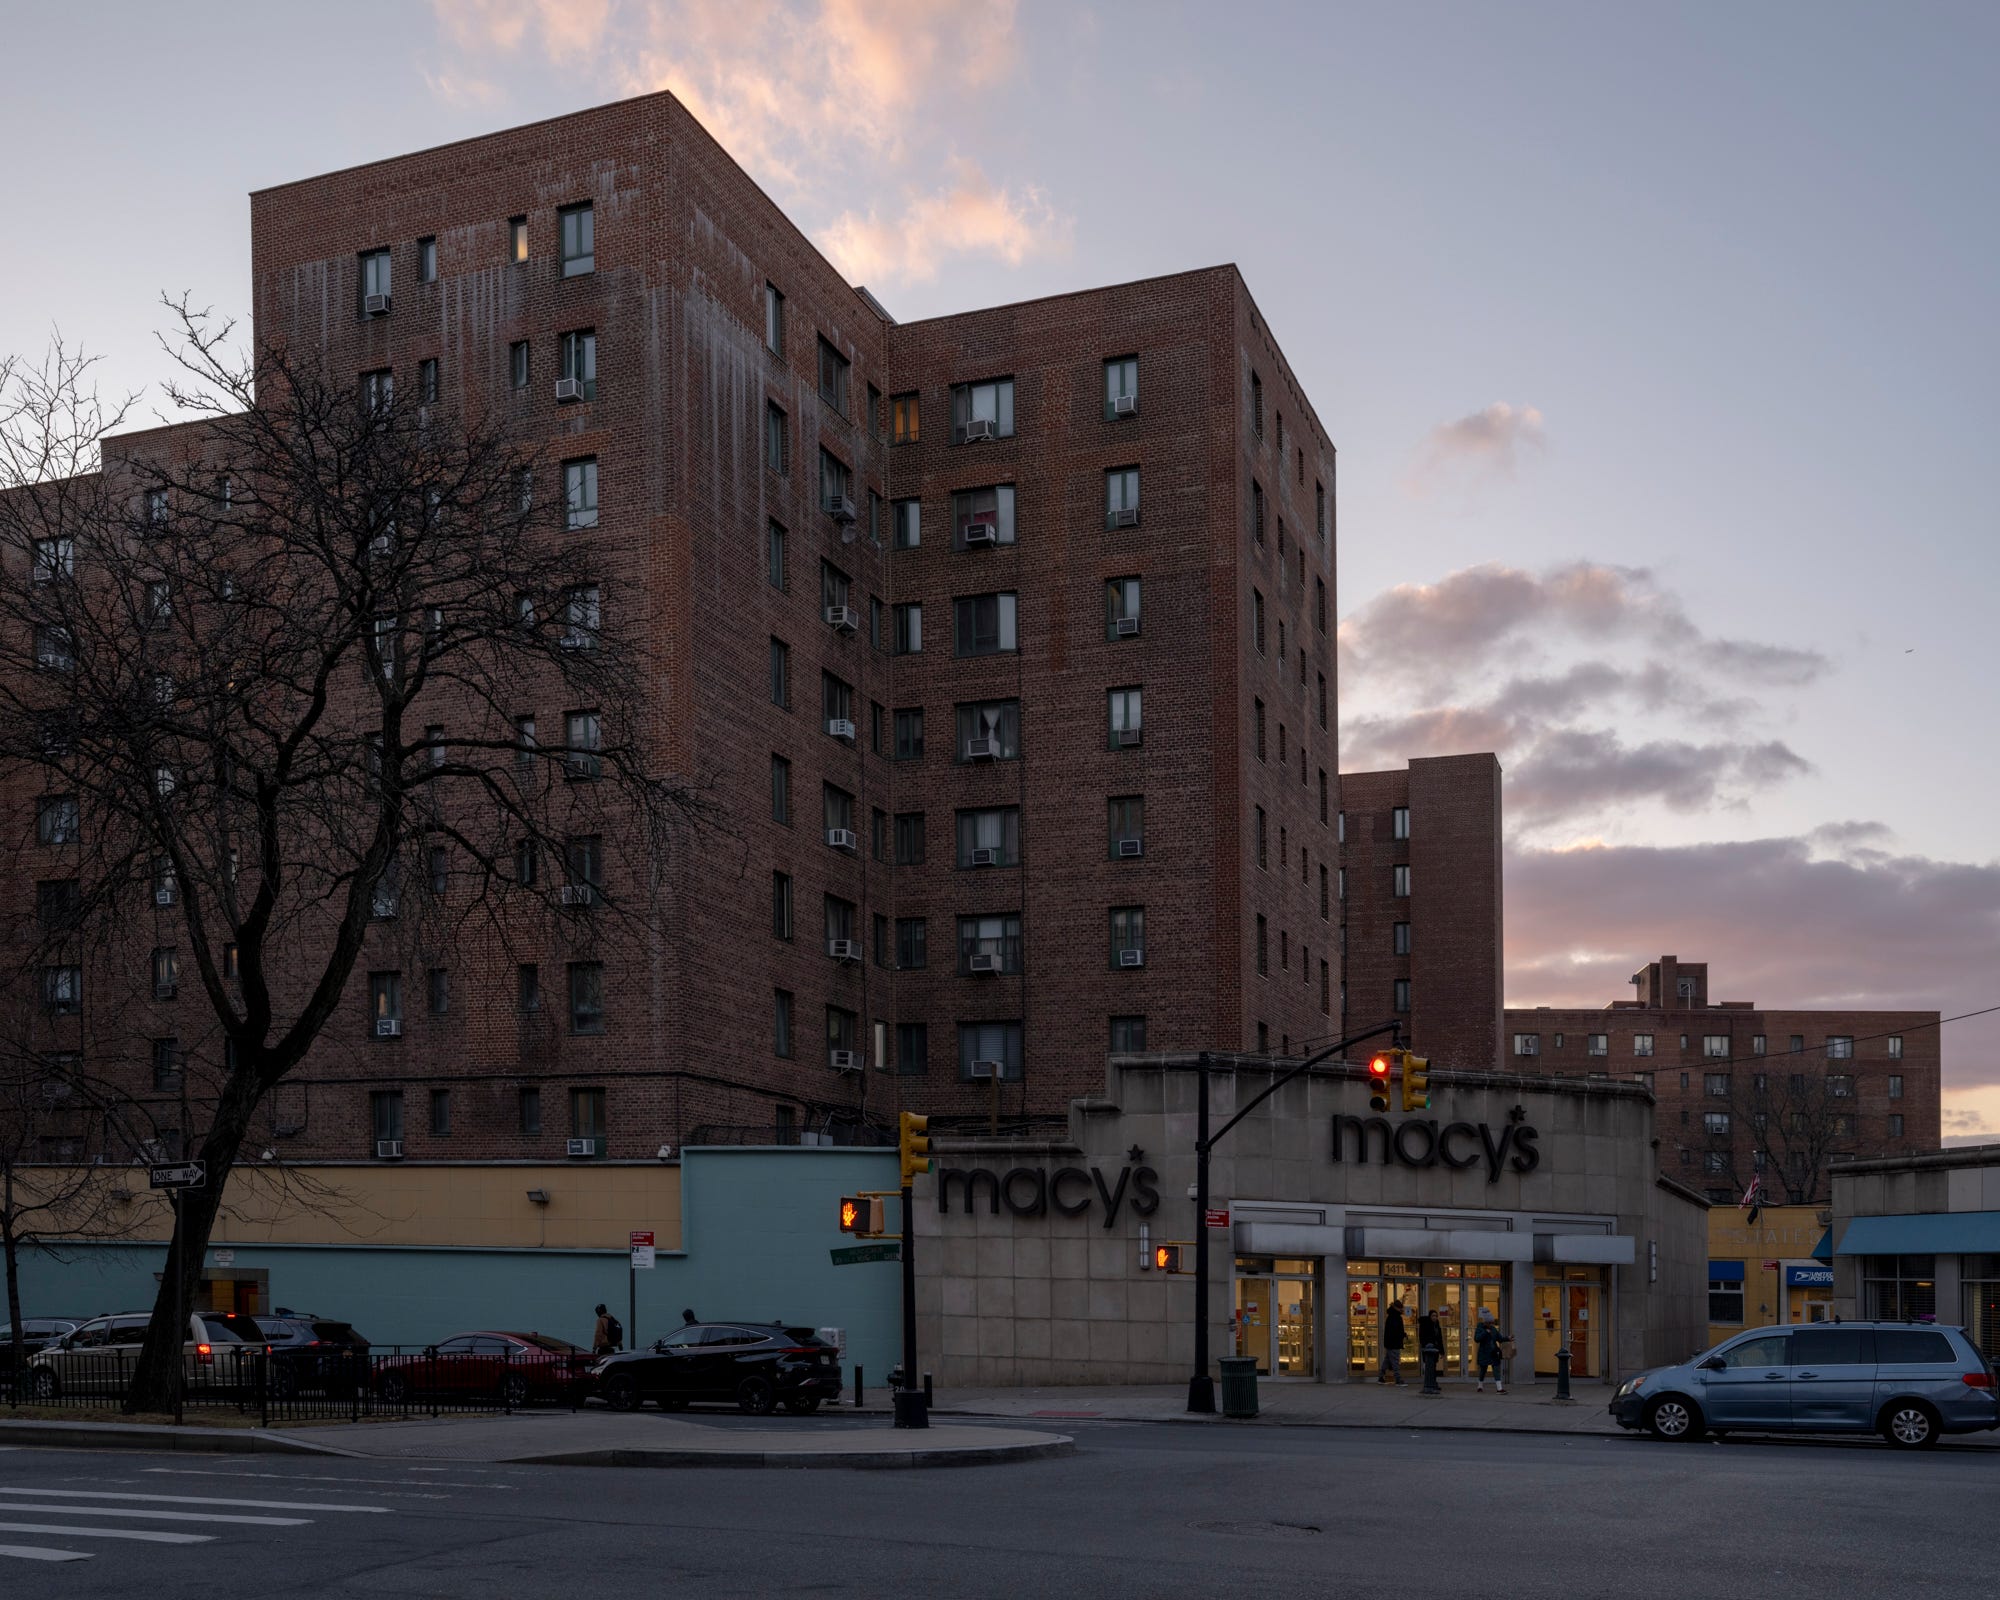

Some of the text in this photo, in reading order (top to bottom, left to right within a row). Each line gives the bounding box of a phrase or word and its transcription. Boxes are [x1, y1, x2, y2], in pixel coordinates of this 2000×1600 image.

[154, 1168, 199, 1182] ONE WAY
[1385, 1264, 1404, 1274] 1411
